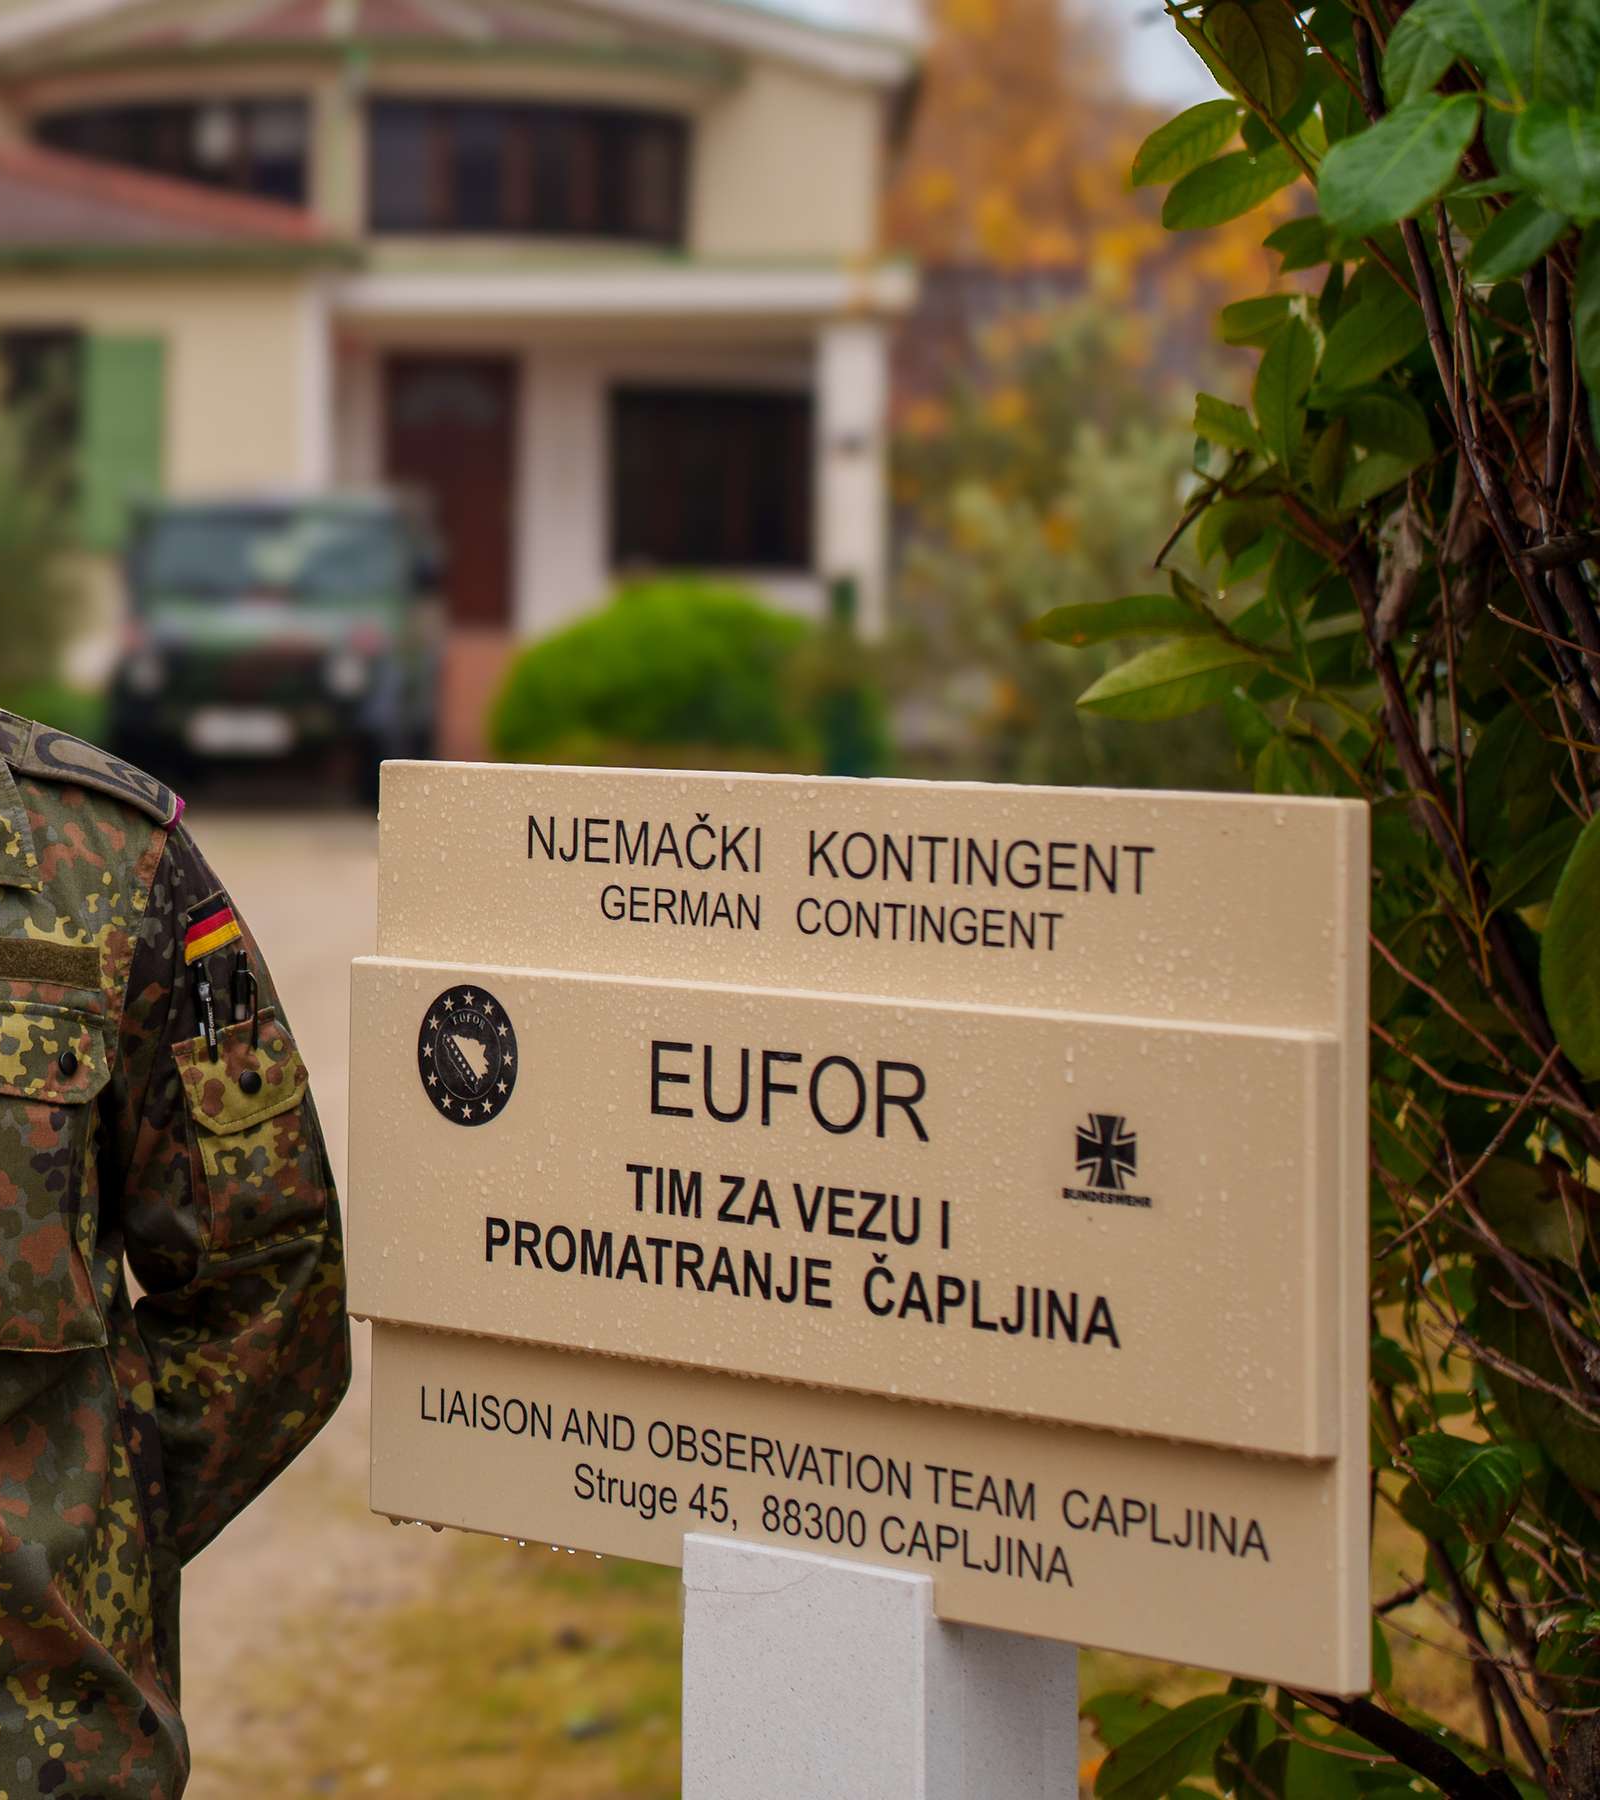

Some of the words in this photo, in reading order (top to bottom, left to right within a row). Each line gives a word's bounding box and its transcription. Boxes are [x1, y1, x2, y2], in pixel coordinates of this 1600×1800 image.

[527, 812, 762, 874] NJEMAČKI
[808, 829, 1156, 895] KONTINGENT
[600, 884, 761, 931] GERMAN
[796, 897, 1065, 953] CONTINGENT
[650, 1039, 930, 1143] EUFOR
[625, 1162, 703, 1220] TIM
[716, 1174, 781, 1230] ZA
[792, 1182, 921, 1247] VEZU
[940, 1199, 951, 1250] I
[485, 1215, 833, 1310] PROMATRANJE
[862, 1251, 1122, 1350] ČAPLJINA
[420, 1385, 552, 1441] LIAISON
[560, 1407, 636, 1452] AND
[647, 1420, 912, 1500] OBSERVATION
[924, 1463, 1036, 1522] TEAM
[1061, 1488, 1270, 1563] CAPLJINA
[573, 1462, 678, 1521] Struge
[688, 1482, 738, 1532] 45,
[761, 1494, 867, 1548] 88300
[879, 1515, 1074, 1588] CAPLJINA
